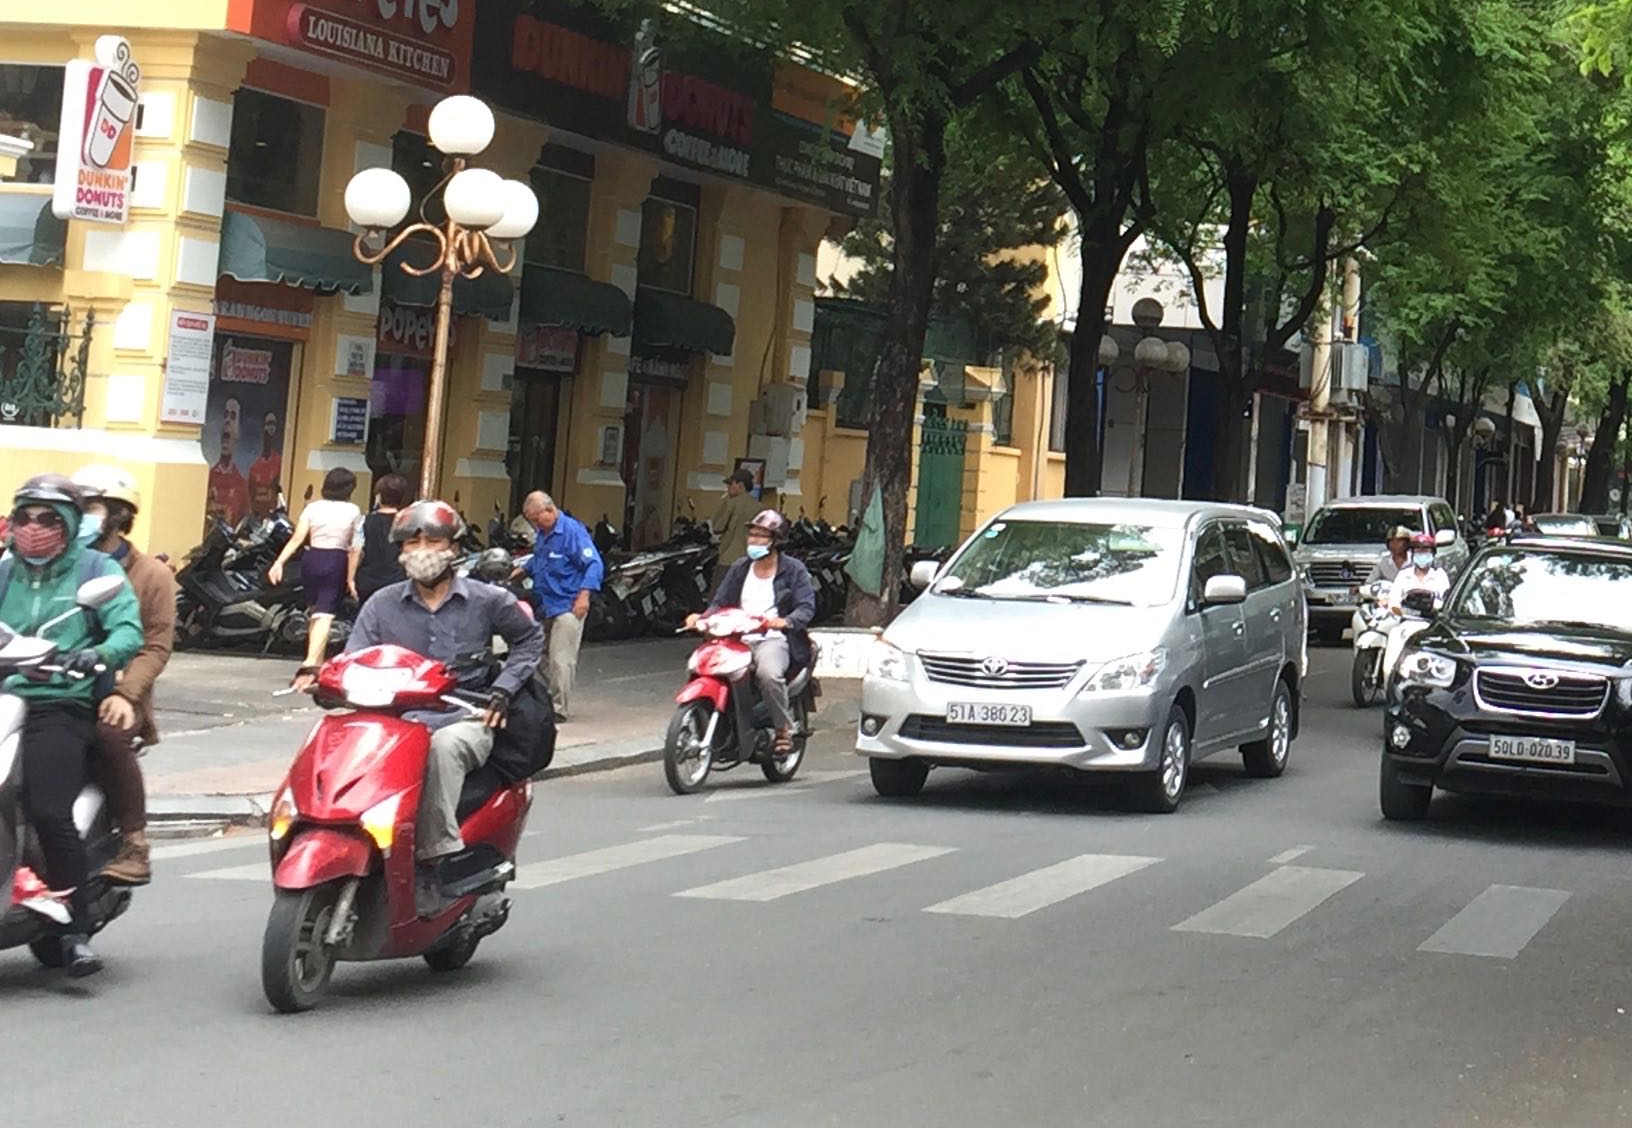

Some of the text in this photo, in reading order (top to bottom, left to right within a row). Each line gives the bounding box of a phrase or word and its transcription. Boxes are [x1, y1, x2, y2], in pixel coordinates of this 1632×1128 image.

[307, 15, 450, 79] LOUISIANA KITCHEN
[76, 187, 125, 209] DONUTS
